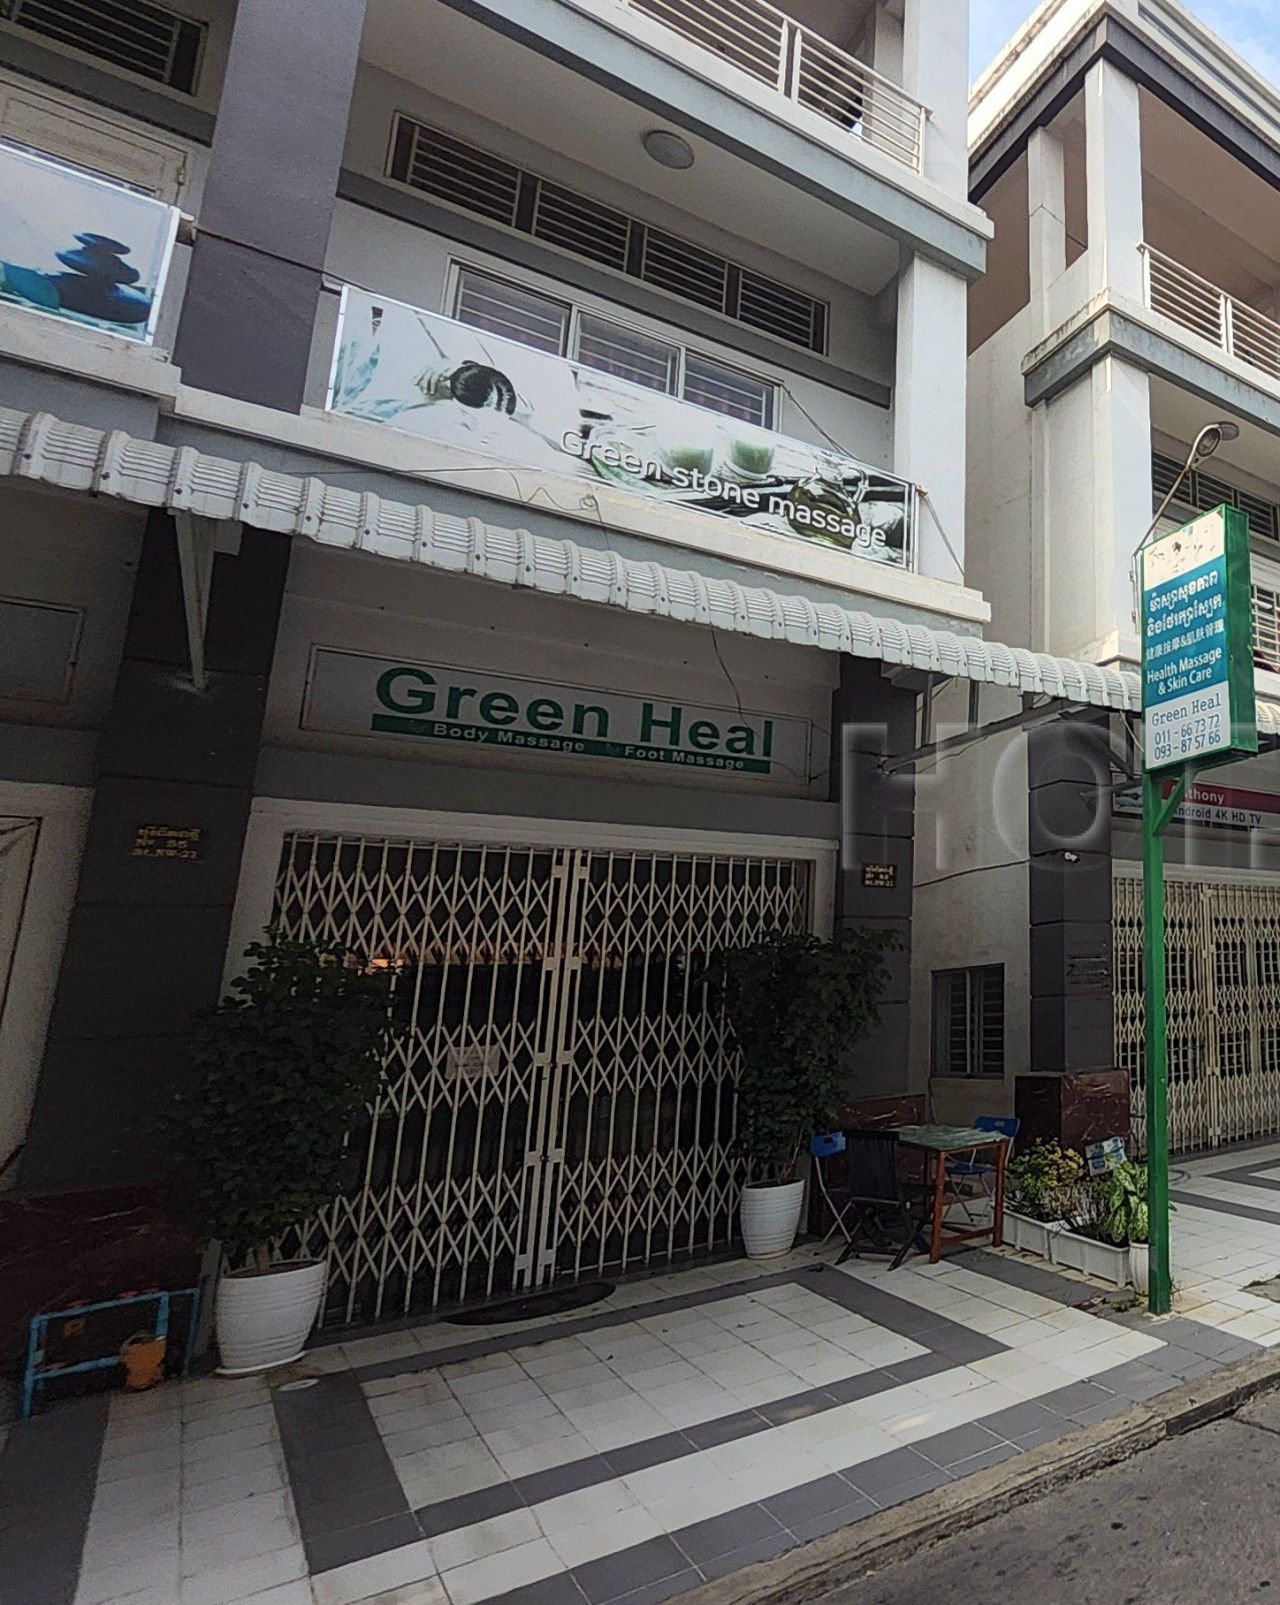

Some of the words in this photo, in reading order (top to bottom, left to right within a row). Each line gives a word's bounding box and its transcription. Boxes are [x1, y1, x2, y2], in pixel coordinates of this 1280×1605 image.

[562, 430, 661, 480] Green
[672, 467, 760, 508] stone
[769, 494, 887, 547] massage
[1147, 662, 1178, 684] Health
[1180, 647, 1222, 672] Massage
[1157, 681, 1166, 695] &
[1167, 675, 1188, 692] Skin
[1189, 667, 1213, 684] Care
[376, 667, 609, 738] Green
[640, 702, 773, 757] Heal
[1152, 706, 1188, 727] Green
[1191, 692, 1222, 715] Heal
[434, 723, 487, 743] Body
[497, 730, 586, 753] Massage
[1154, 729, 1171, 745] 011
[1181, 722, 1193, 738] 66
[1194, 718, 1206, 735] 73
[1208, 714, 1220, 730] 72
[1154, 744, 1172, 760] 093
[1181, 738, 1193, 753] 87
[1195, 734, 1206, 750] 57
[1208, 729, 1221, 745] 66
[625, 745, 665, 761] Foot
[672, 749, 744, 770] Massage
[1215, 808, 1228, 821] 4K
[1231, 811, 1246, 823] HD
[1249, 814, 1262, 825] TV
